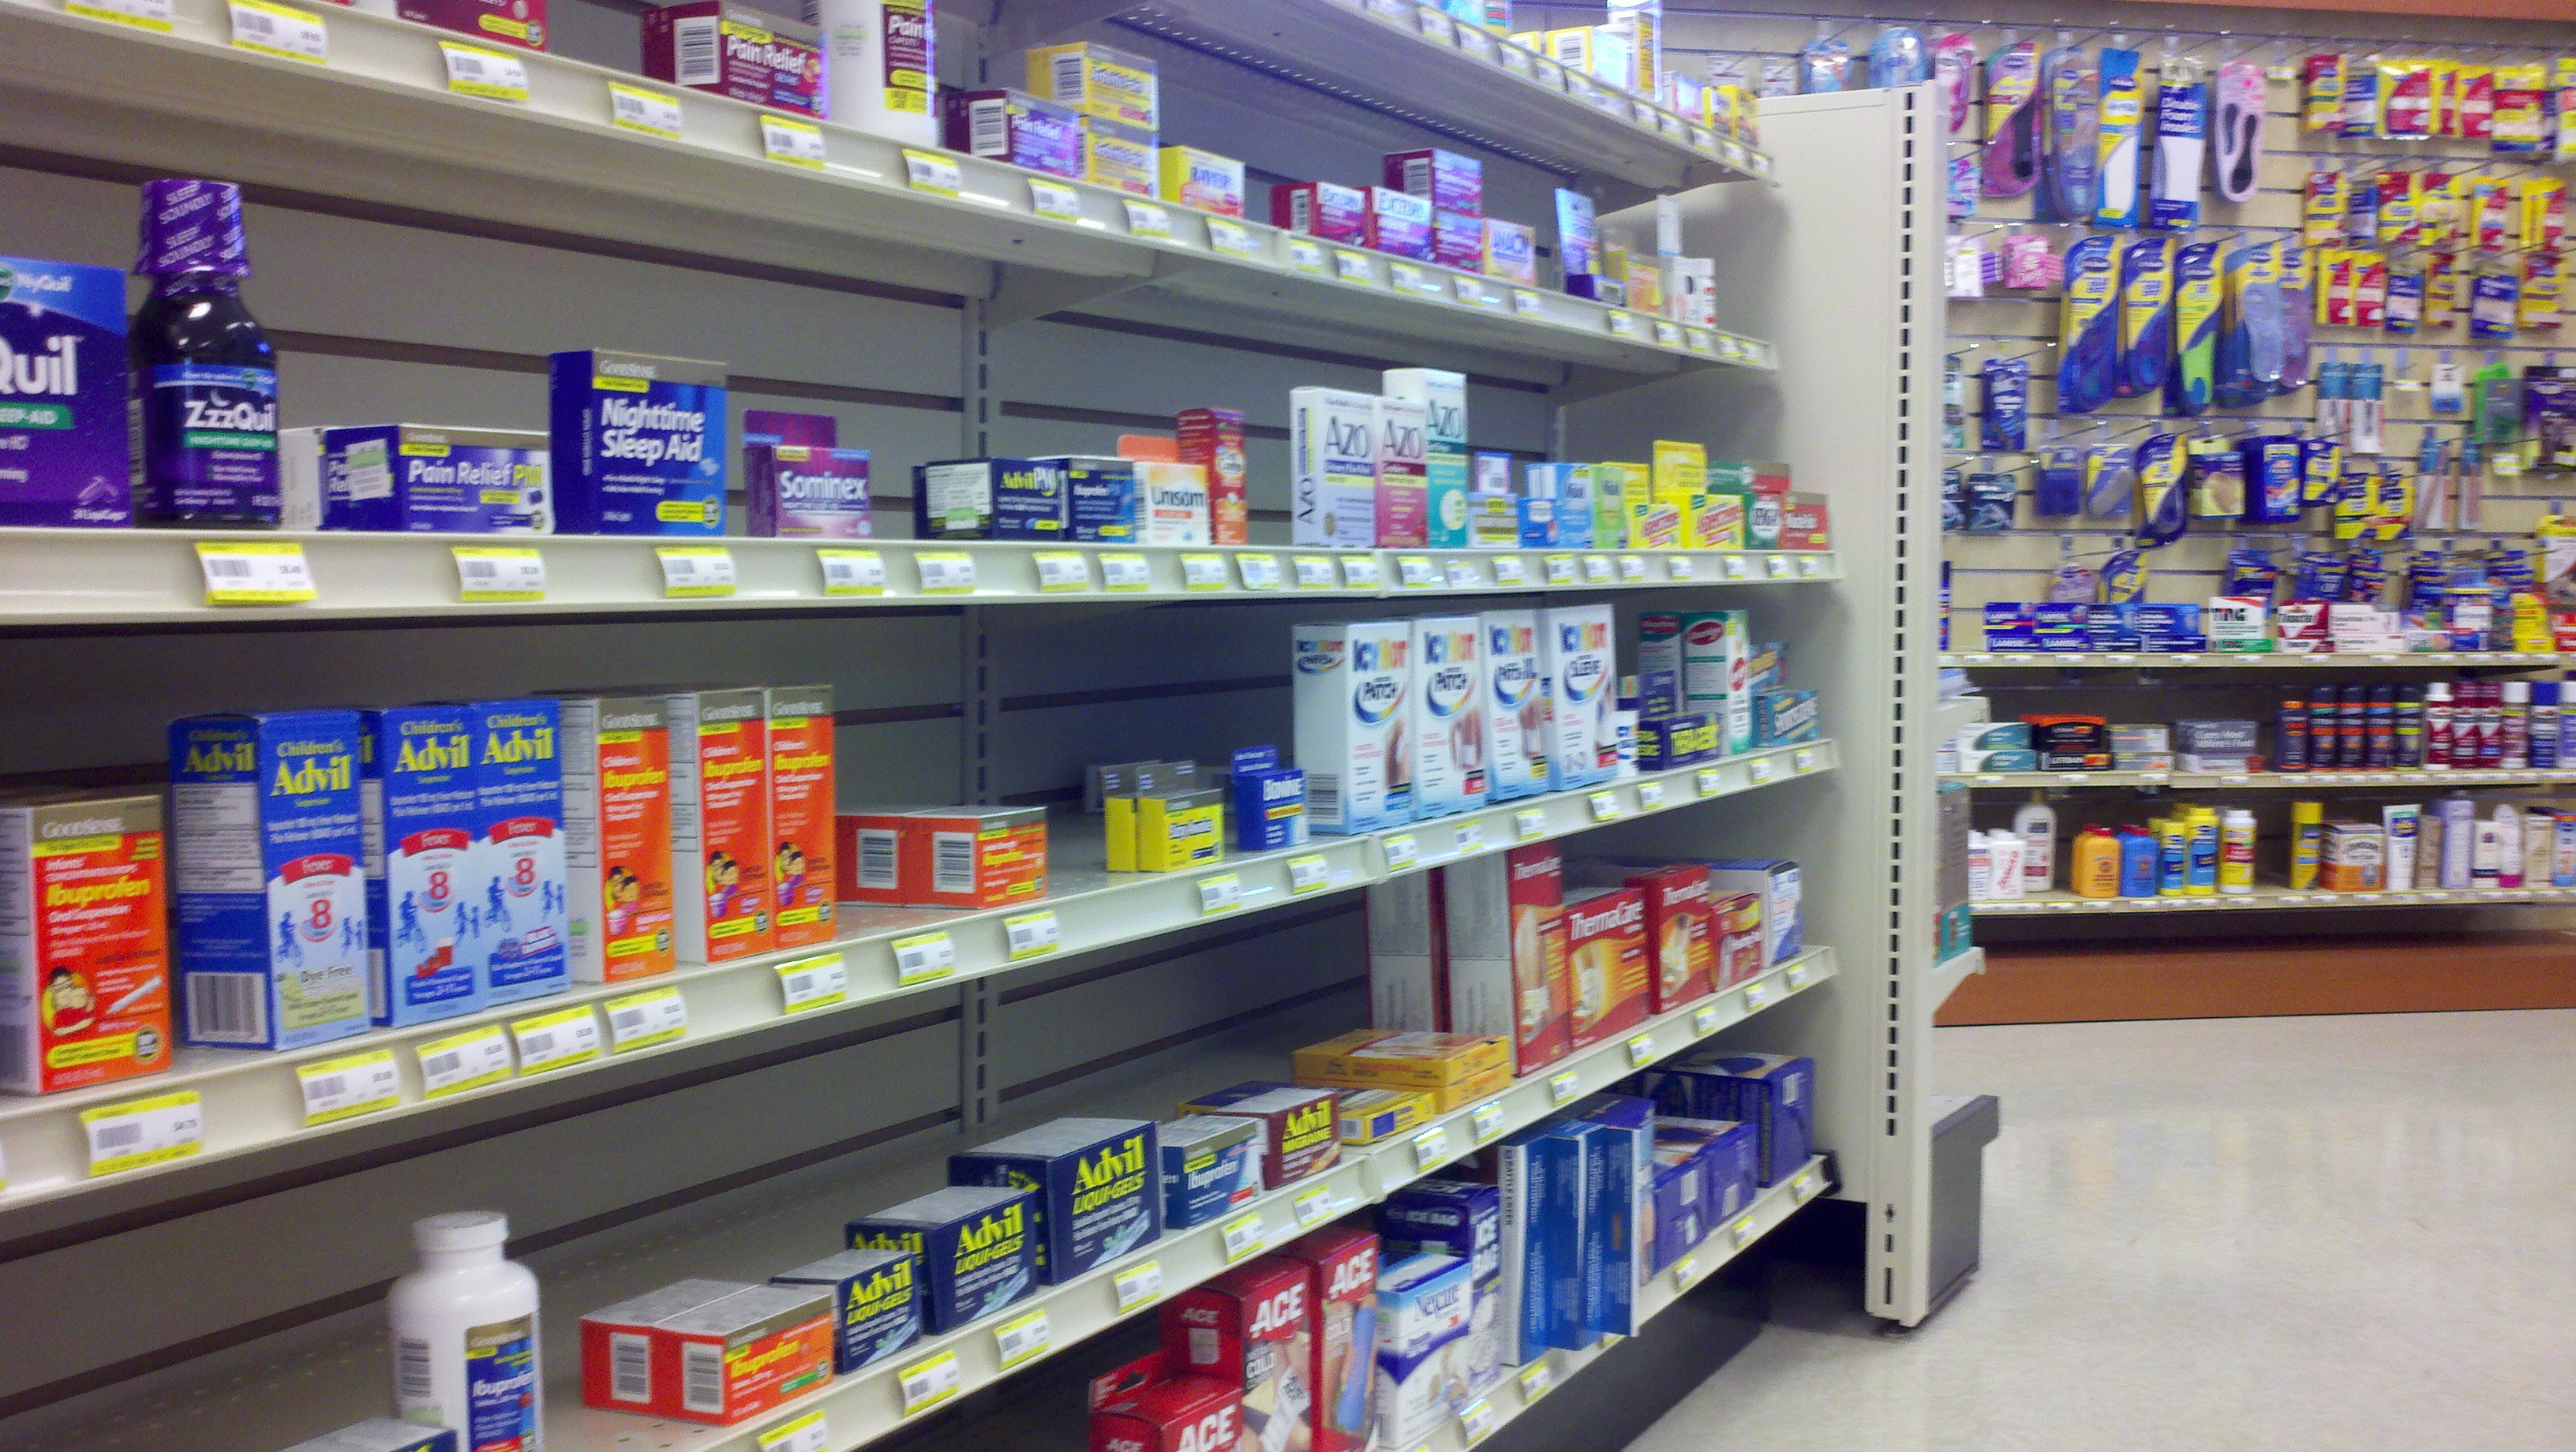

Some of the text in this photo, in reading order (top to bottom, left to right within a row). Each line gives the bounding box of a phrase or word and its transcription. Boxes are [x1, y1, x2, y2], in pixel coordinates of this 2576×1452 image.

[888, 13, 923, 36] Pain
[726, 35, 807, 74] Pain Relief
[0, 335, 84, 395] uil
[185, 400, 276, 432] ZzzQuil
[601, 398, 706, 434] Nighttime
[601, 430, 702, 466] Sleep Aid
[408, 458, 455, 485] Pain
[457, 462, 513, 486] Relief
[780, 470, 866, 500] Sominex
[1001, 471, 1035, 489] Advil
[1151, 486, 1206, 507] Unisom
[399, 719, 464, 737] Children's
[487, 713, 548, 730] Children's
[182, 741, 255, 773] Advil
[277, 739, 344, 758] Children's
[394, 733, 471, 773] Advil
[481, 727, 554, 765] Advil
[270, 754, 354, 797] Advil
[604, 767, 667, 790] Ibuprofen
[703, 756, 764, 780] Ibuprofen
[773, 752, 830, 773] Ibuprofen
[429, 870, 449, 900] 8
[515, 857, 536, 886] 8
[47, 876, 151, 908] Ibuprofen
[310, 898, 331, 930] 8
[1569, 900, 1644, 941] ThermaCare
[301, 966, 326, 986] Dye
[1282, 1098, 1332, 1140] Advil
[1072, 1133, 1146, 1196] Advil
[1187, 1157, 1239, 1191] Ibuprofen
[1072, 1171, 1147, 1216] LIQUI-GELS
[953, 1203, 1024, 1258] Advil
[954, 1236, 1024, 1275] LIQUI-GELS
[847, 1258, 912, 1311] Advil
[1328, 1248, 1376, 1299] ACE
[1181, 1307, 1220, 1323] ACE
[1249, 1282, 1305, 1336] ACE
[731, 1338, 799, 1378] Ibuprofen
[1178, 1405, 1237, 1452] ACE
[1106, 1438, 1144, 1452] ACE
